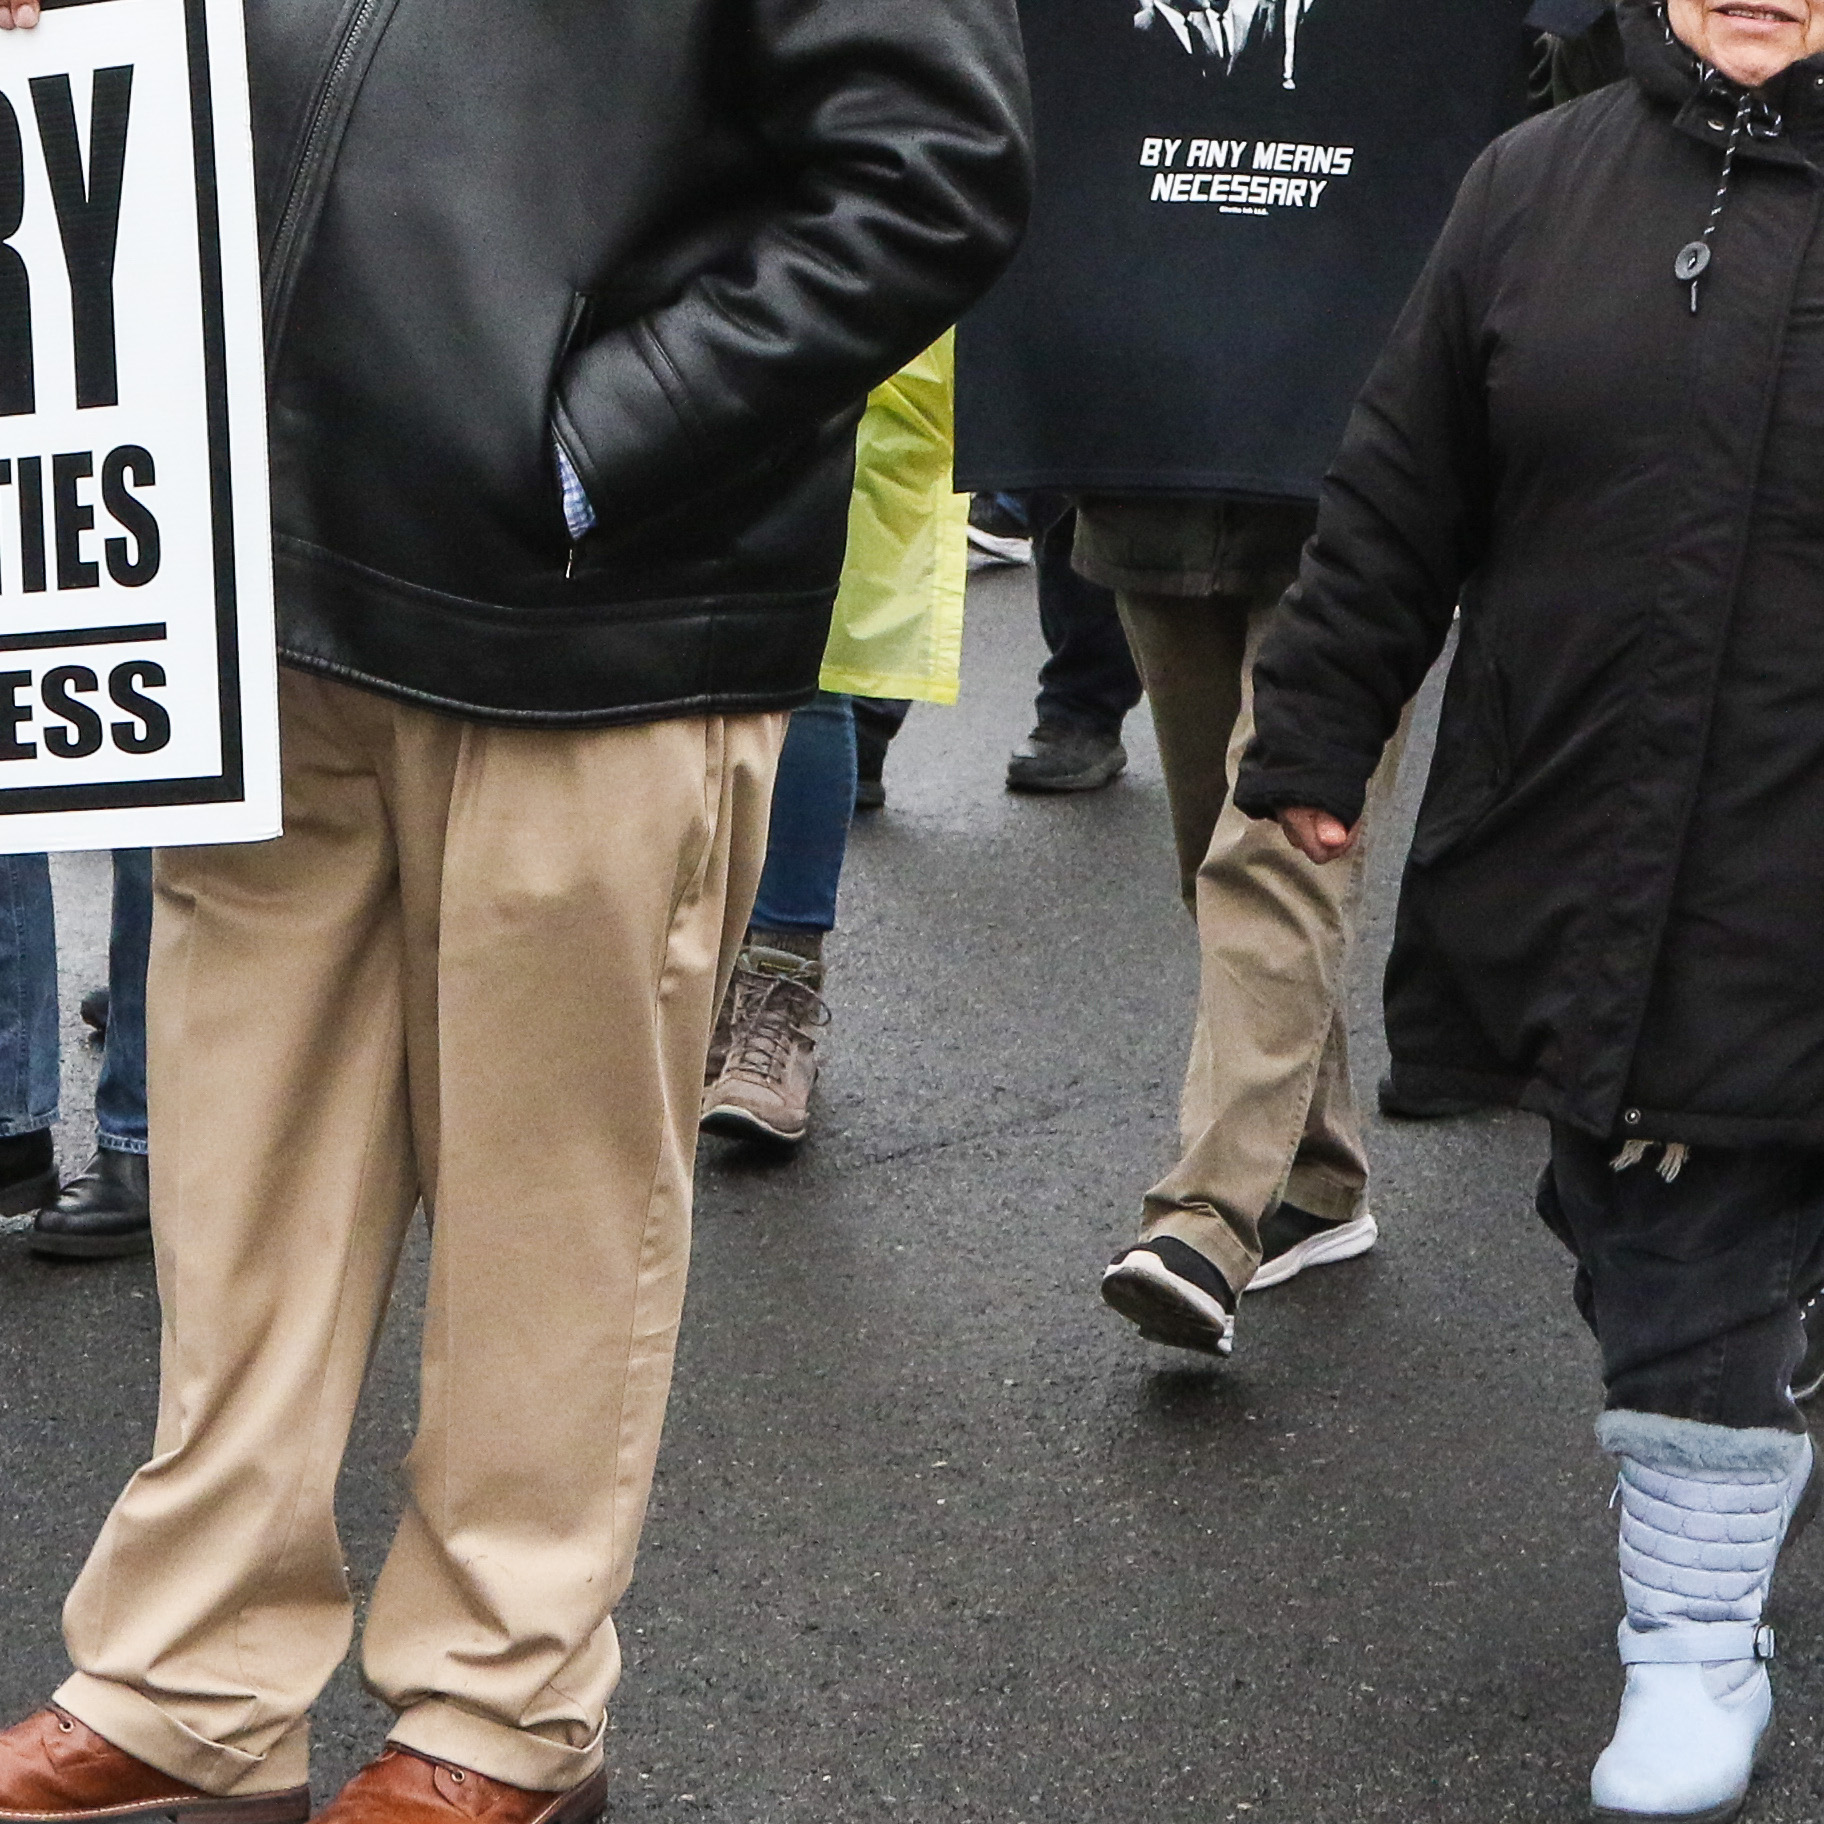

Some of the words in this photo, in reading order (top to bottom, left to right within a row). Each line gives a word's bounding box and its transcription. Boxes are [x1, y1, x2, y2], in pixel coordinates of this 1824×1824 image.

[1139, 137, 1182, 168] BY
[1186, 139, 1248, 169] ANY
[1252, 141, 1354, 176] MEANS
[1150, 173, 1328, 209] NECESSARY
